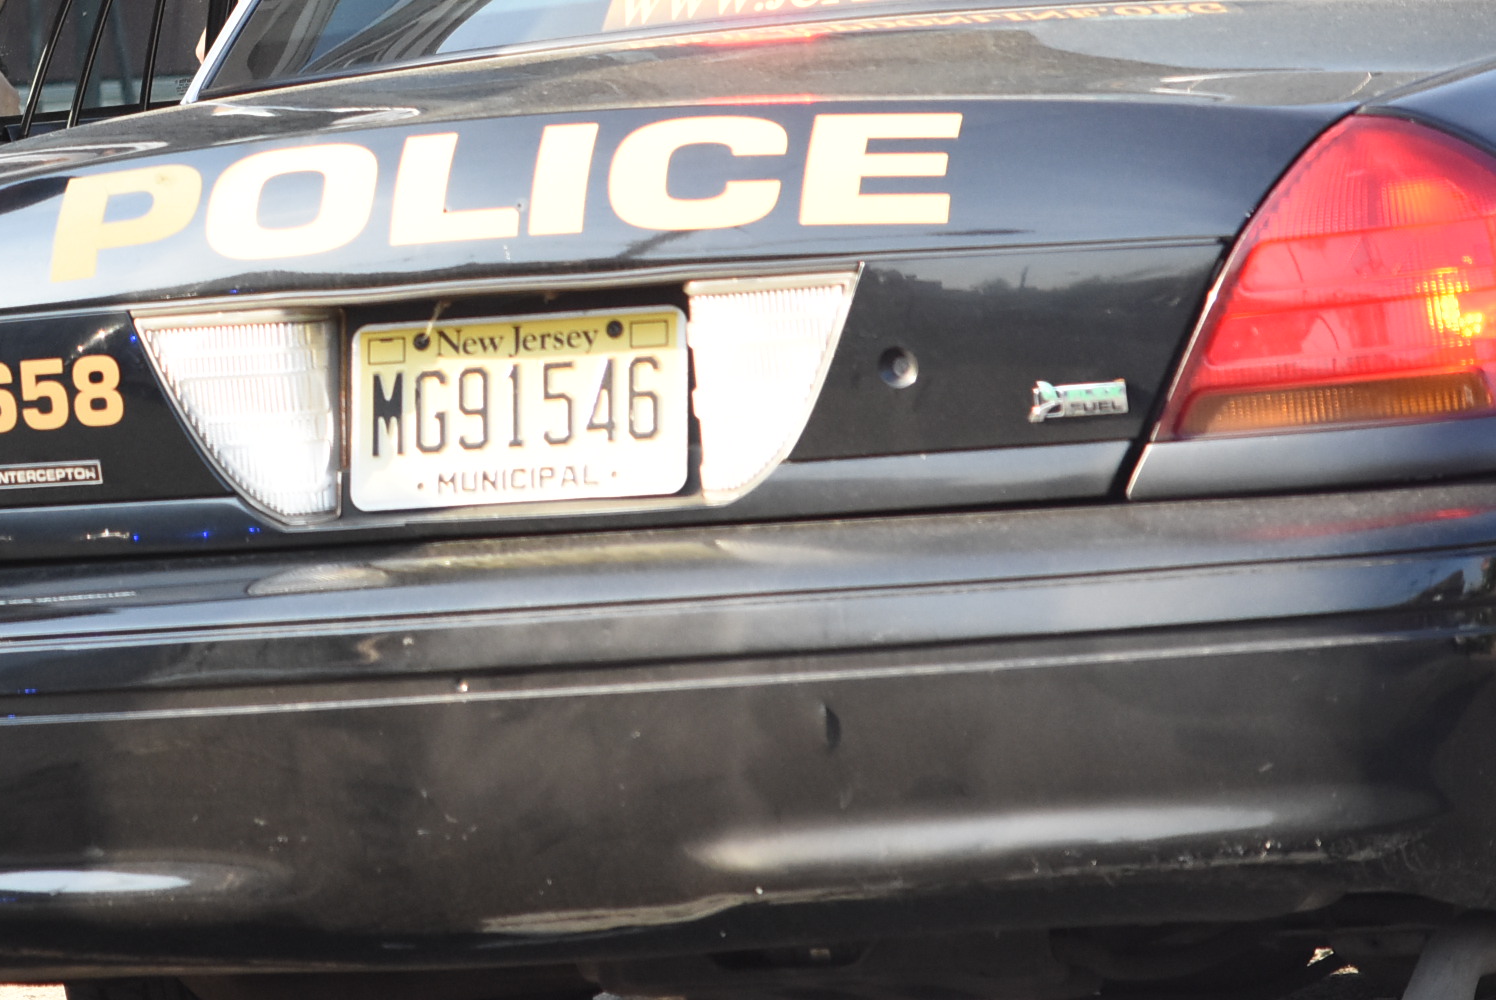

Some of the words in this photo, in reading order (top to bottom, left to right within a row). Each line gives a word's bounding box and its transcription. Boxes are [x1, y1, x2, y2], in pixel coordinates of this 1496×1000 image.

[50, 113, 964, 283] POLICE
[436, 328, 505, 356] New
[509, 325, 600, 358] Jersey
[371, 355, 660, 458] MG91546
[436, 463, 600, 495] MUNICIPAL
